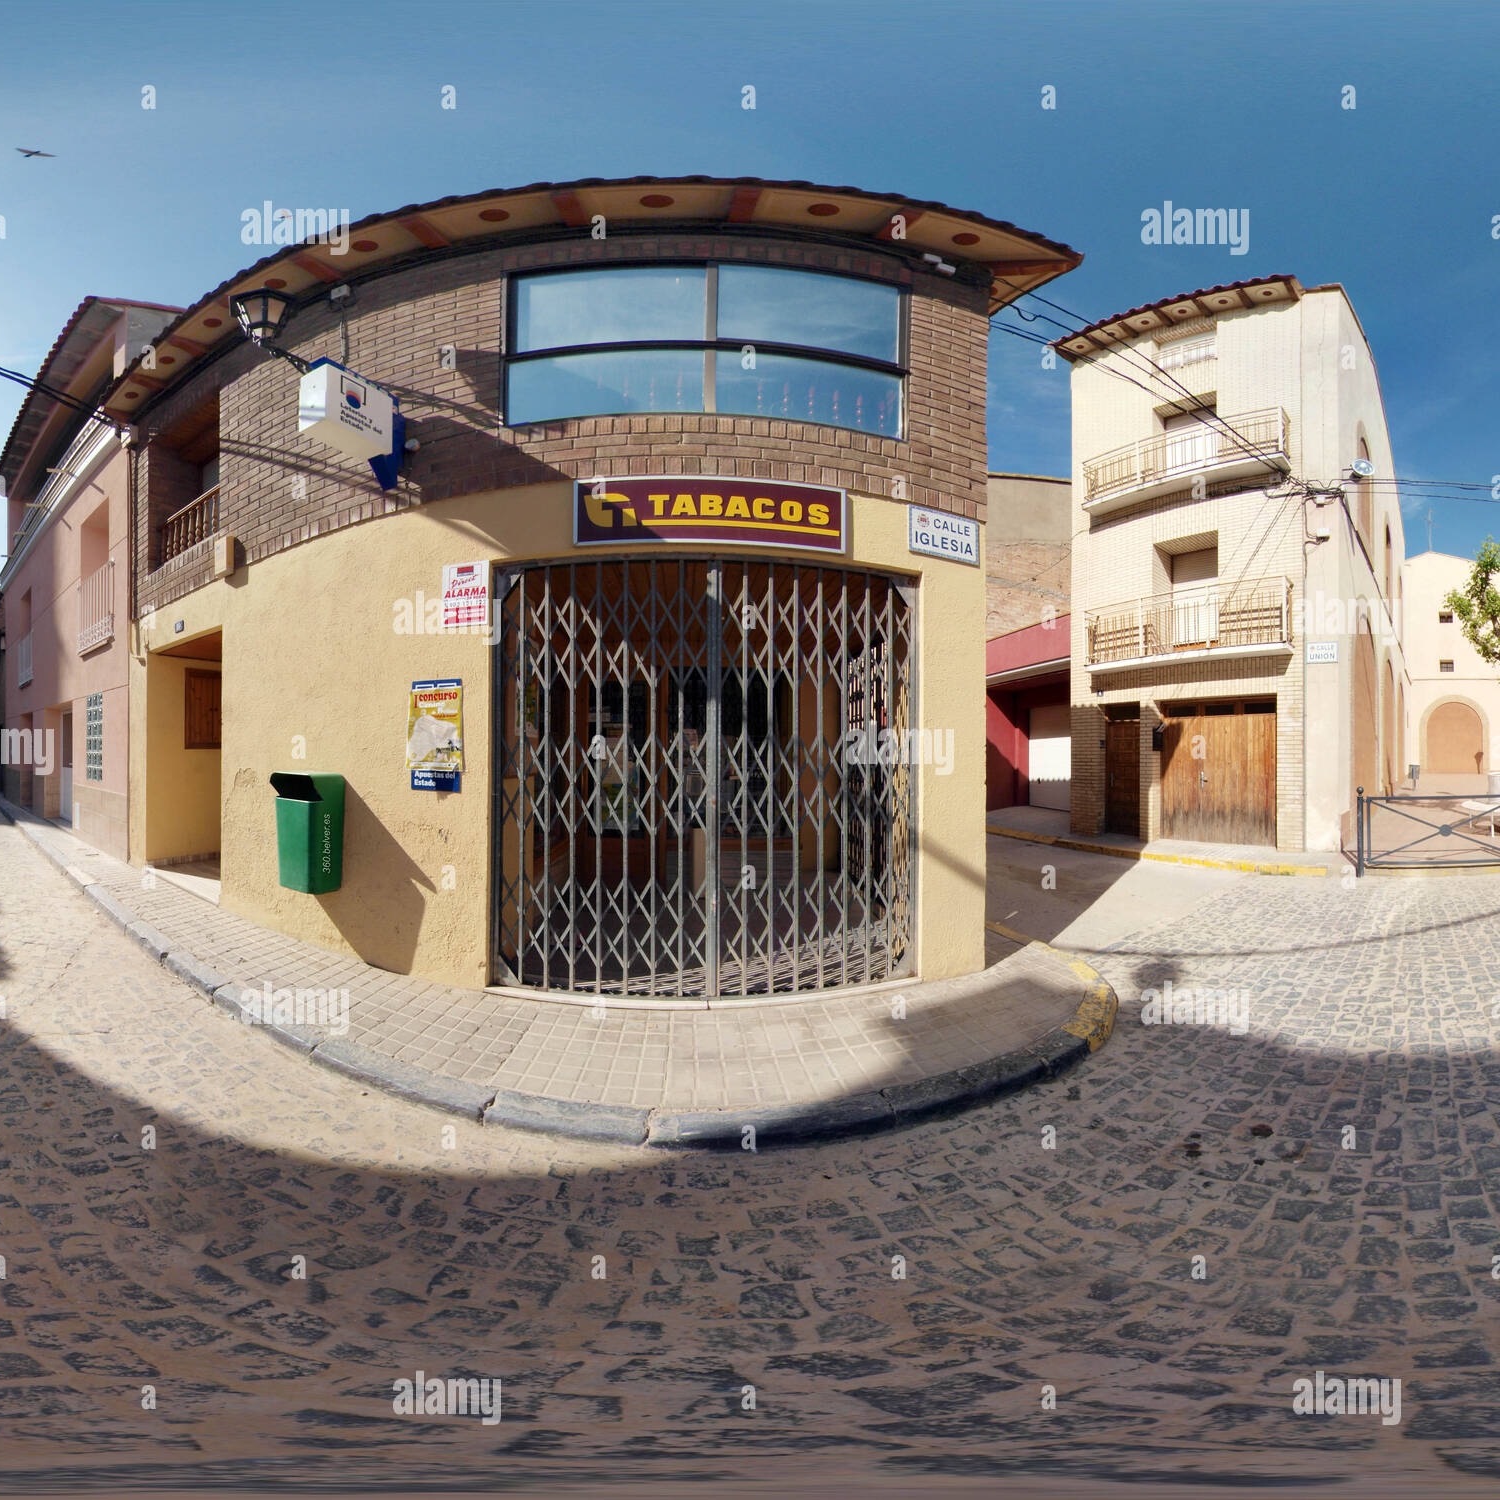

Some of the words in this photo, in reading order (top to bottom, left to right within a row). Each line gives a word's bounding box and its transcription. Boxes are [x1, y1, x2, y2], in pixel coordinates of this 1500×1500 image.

[648, 493, 831, 526] TABACOS
[933, 518, 971, 537] CALLE
[915, 530, 973, 556] IGLESIA
[444, 586, 487, 599] ALARMA
[418, 691, 458, 702] concurso
[414, 770, 444, 779] Apuestas
[414, 778, 437, 787] Estado
[322, 813, 332, 874] 360.belver.es
